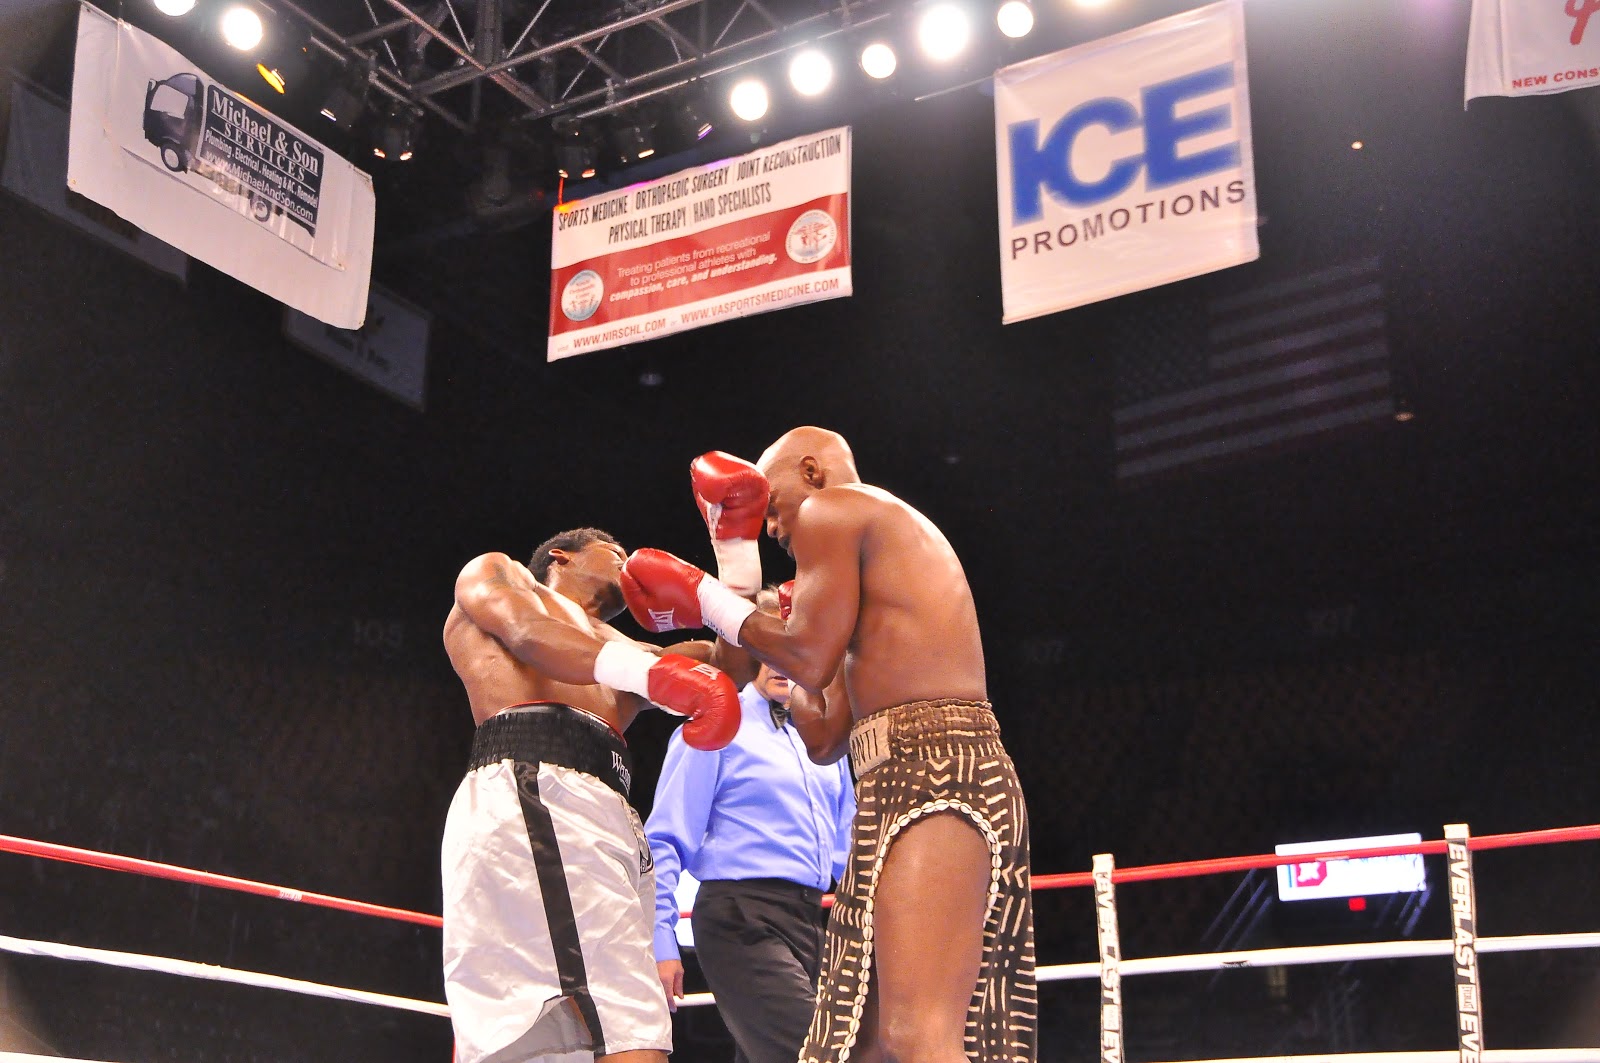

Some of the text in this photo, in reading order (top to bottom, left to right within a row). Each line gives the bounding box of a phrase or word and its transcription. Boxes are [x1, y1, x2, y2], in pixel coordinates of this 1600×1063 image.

[1512, 67, 1600, 88] NEW CONS
[205, 129, 232, 158] Plumbing
[235, 147, 260, 171] Electrical
[262, 164, 282, 188] Heating
[213, 90, 318, 175] Michael & Son
[224, 122, 305, 181] SERVICES
[1007, 61, 1241, 228] ICE
[206, 151, 313, 221] www.MichaelAndSon.com
[558, 134, 841, 230] SPORTS MEDICINE ORTHOPAEDIC SURGERY JOINT RECONSTRUCTION
[609, 182, 771, 244] PHYSICAL THERAPY HAND SPECIALISTS
[617, 231, 770, 278] Treating patients from recreational
[1012, 181, 1245, 260] PROMOTIONS
[610, 282, 664, 302] compassion,
[666, 275, 689, 289] care,
[691, 270, 709, 282] and
[710, 253, 777, 278] understanding.
[630, 248, 756, 286] to professional athletes with
[573, 318, 666, 348] WWW.NIRSCHL.COM
[681, 279, 839, 323] WWW.VASPORTSMEDICINE.COM
[1095, 878, 1120, 1005] EVERLAST
[1449, 843, 1476, 984] EVERLAST
